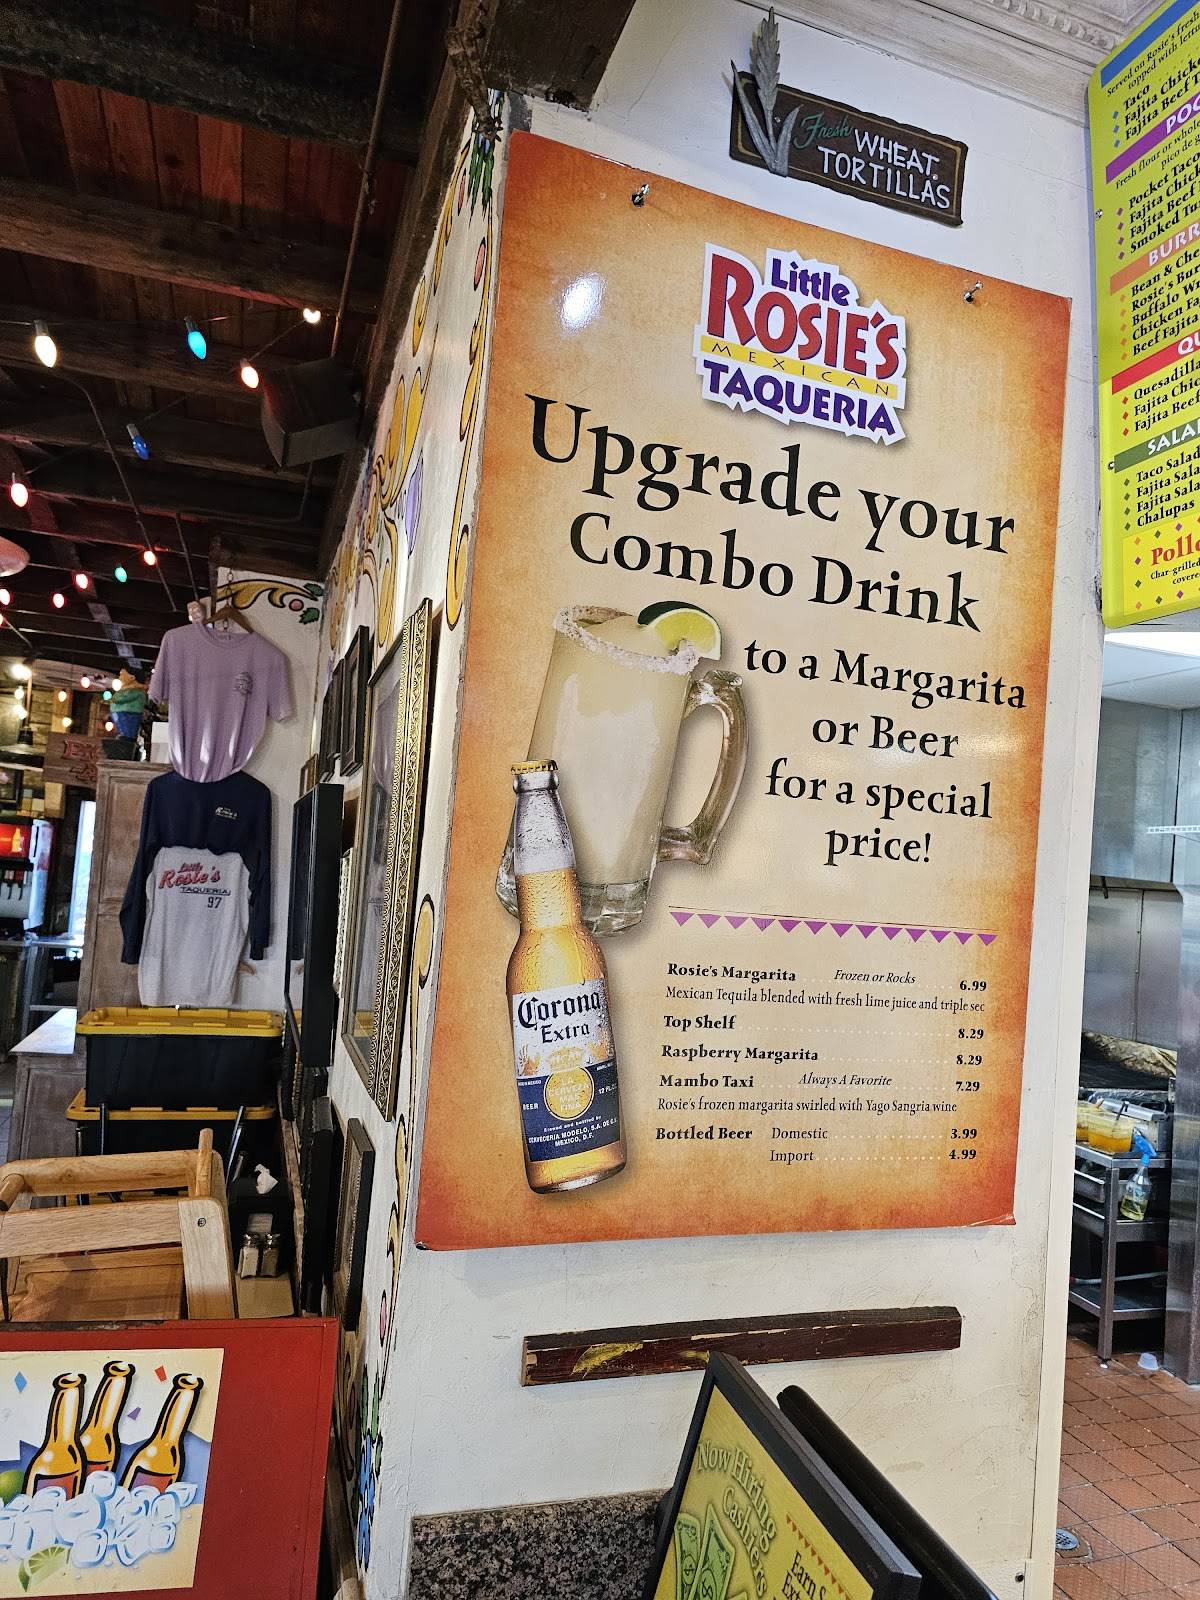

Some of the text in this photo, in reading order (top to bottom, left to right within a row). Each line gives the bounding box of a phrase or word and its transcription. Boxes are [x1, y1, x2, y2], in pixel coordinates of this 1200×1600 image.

[1107, 68, 1132, 96] Served
[1135, 60, 1145, 73] on
[1147, 34, 1175, 61] Rosie's
[1128, 59, 1156, 89] topped
[1159, 42, 1178, 63] with
[1125, 84, 1150, 111] Taco
[1125, 94, 1158, 126] Fajita
[1126, 109, 1159, 140] Fajita
[1161, 77, 1191, 111] Beef
[793, 111, 940, 177] Fresh WHEAT
[1161, 150, 1180, 171] pico
[1182, 139, 1193, 152] de
[818, 145, 951, 209] TORTILLAS
[1116, 168, 1137, 189] Fresh
[1139, 151, 1161, 171] flour
[1162, 143, 1173, 153] or
[1129, 174, 1169, 209] Pocket
[1129, 196, 1163, 224] Fajita
[1130, 181, 1197, 239] Fajita Beef
[1131, 210, 1180, 254] Smoked
[771, 257, 850, 307] Little
[1132, 273, 1161, 297] Bean
[1163, 264, 1173, 276] &
[1132, 281, 1174, 312] Rosie's
[1132, 293, 1179, 327] Buffalo
[1132, 296, 1200, 341] Chicken Fa
[1133, 313, 1198, 357] Beef Fajita
[711, 342, 889, 396] MEXICAN
[703, 360, 896, 436] TAQUERIA
[1134, 394, 1169, 416] Fajita
[1135, 410, 1169, 432] Fajita
[1147, 422, 1200, 456] SALA
[525, 394, 1015, 553] Upgrade your
[1136, 466, 1163, 483] Taco
[1136, 478, 1171, 498] Fajita
[1137, 493, 1171, 513] Fajita
[1137, 500, 1195, 527] Chalupas
[569, 512, 981, 633] Combo Drink
[743, 640, 1027, 709] to a Margarita
[812, 715, 959, 758] or Beer
[765, 758, 993, 820] for a special
[823, 828, 932, 866] price!
[158, 866, 221, 889] Rosie's
[179, 886, 230, 896] TAQUERIA
[207, 897, 222, 909] 97
[667, 963, 988, 992] Rosie's Margarita Frozen or Rocks 6.99
[517, 992, 601, 1030] Corona
[666, 986, 985, 1015] Mexican Tequila blended with fresh lime juice and triple sec
[541, 1024, 590, 1043] Extra
[663, 1014, 984, 1040] Top Shelf 8.29
[661, 1043, 983, 1066] Raspberry Margarita 8.29
[659, 1072, 981, 1092] Mambo Taxi Always A Favorite 7.29
[657, 1096, 957, 1116] Rosie's frozen margarita swirled with Yago Sangria wine
[655, 1125, 978, 1140] Bottled Beer Domestic 3.99
[769, 1149, 977, 1166] Import 4.99
[697, 1441, 777, 1554] Now Hiring
[723, 1486, 768, 1598] Cashiers
[791, 1550, 816, 1600] Earn
